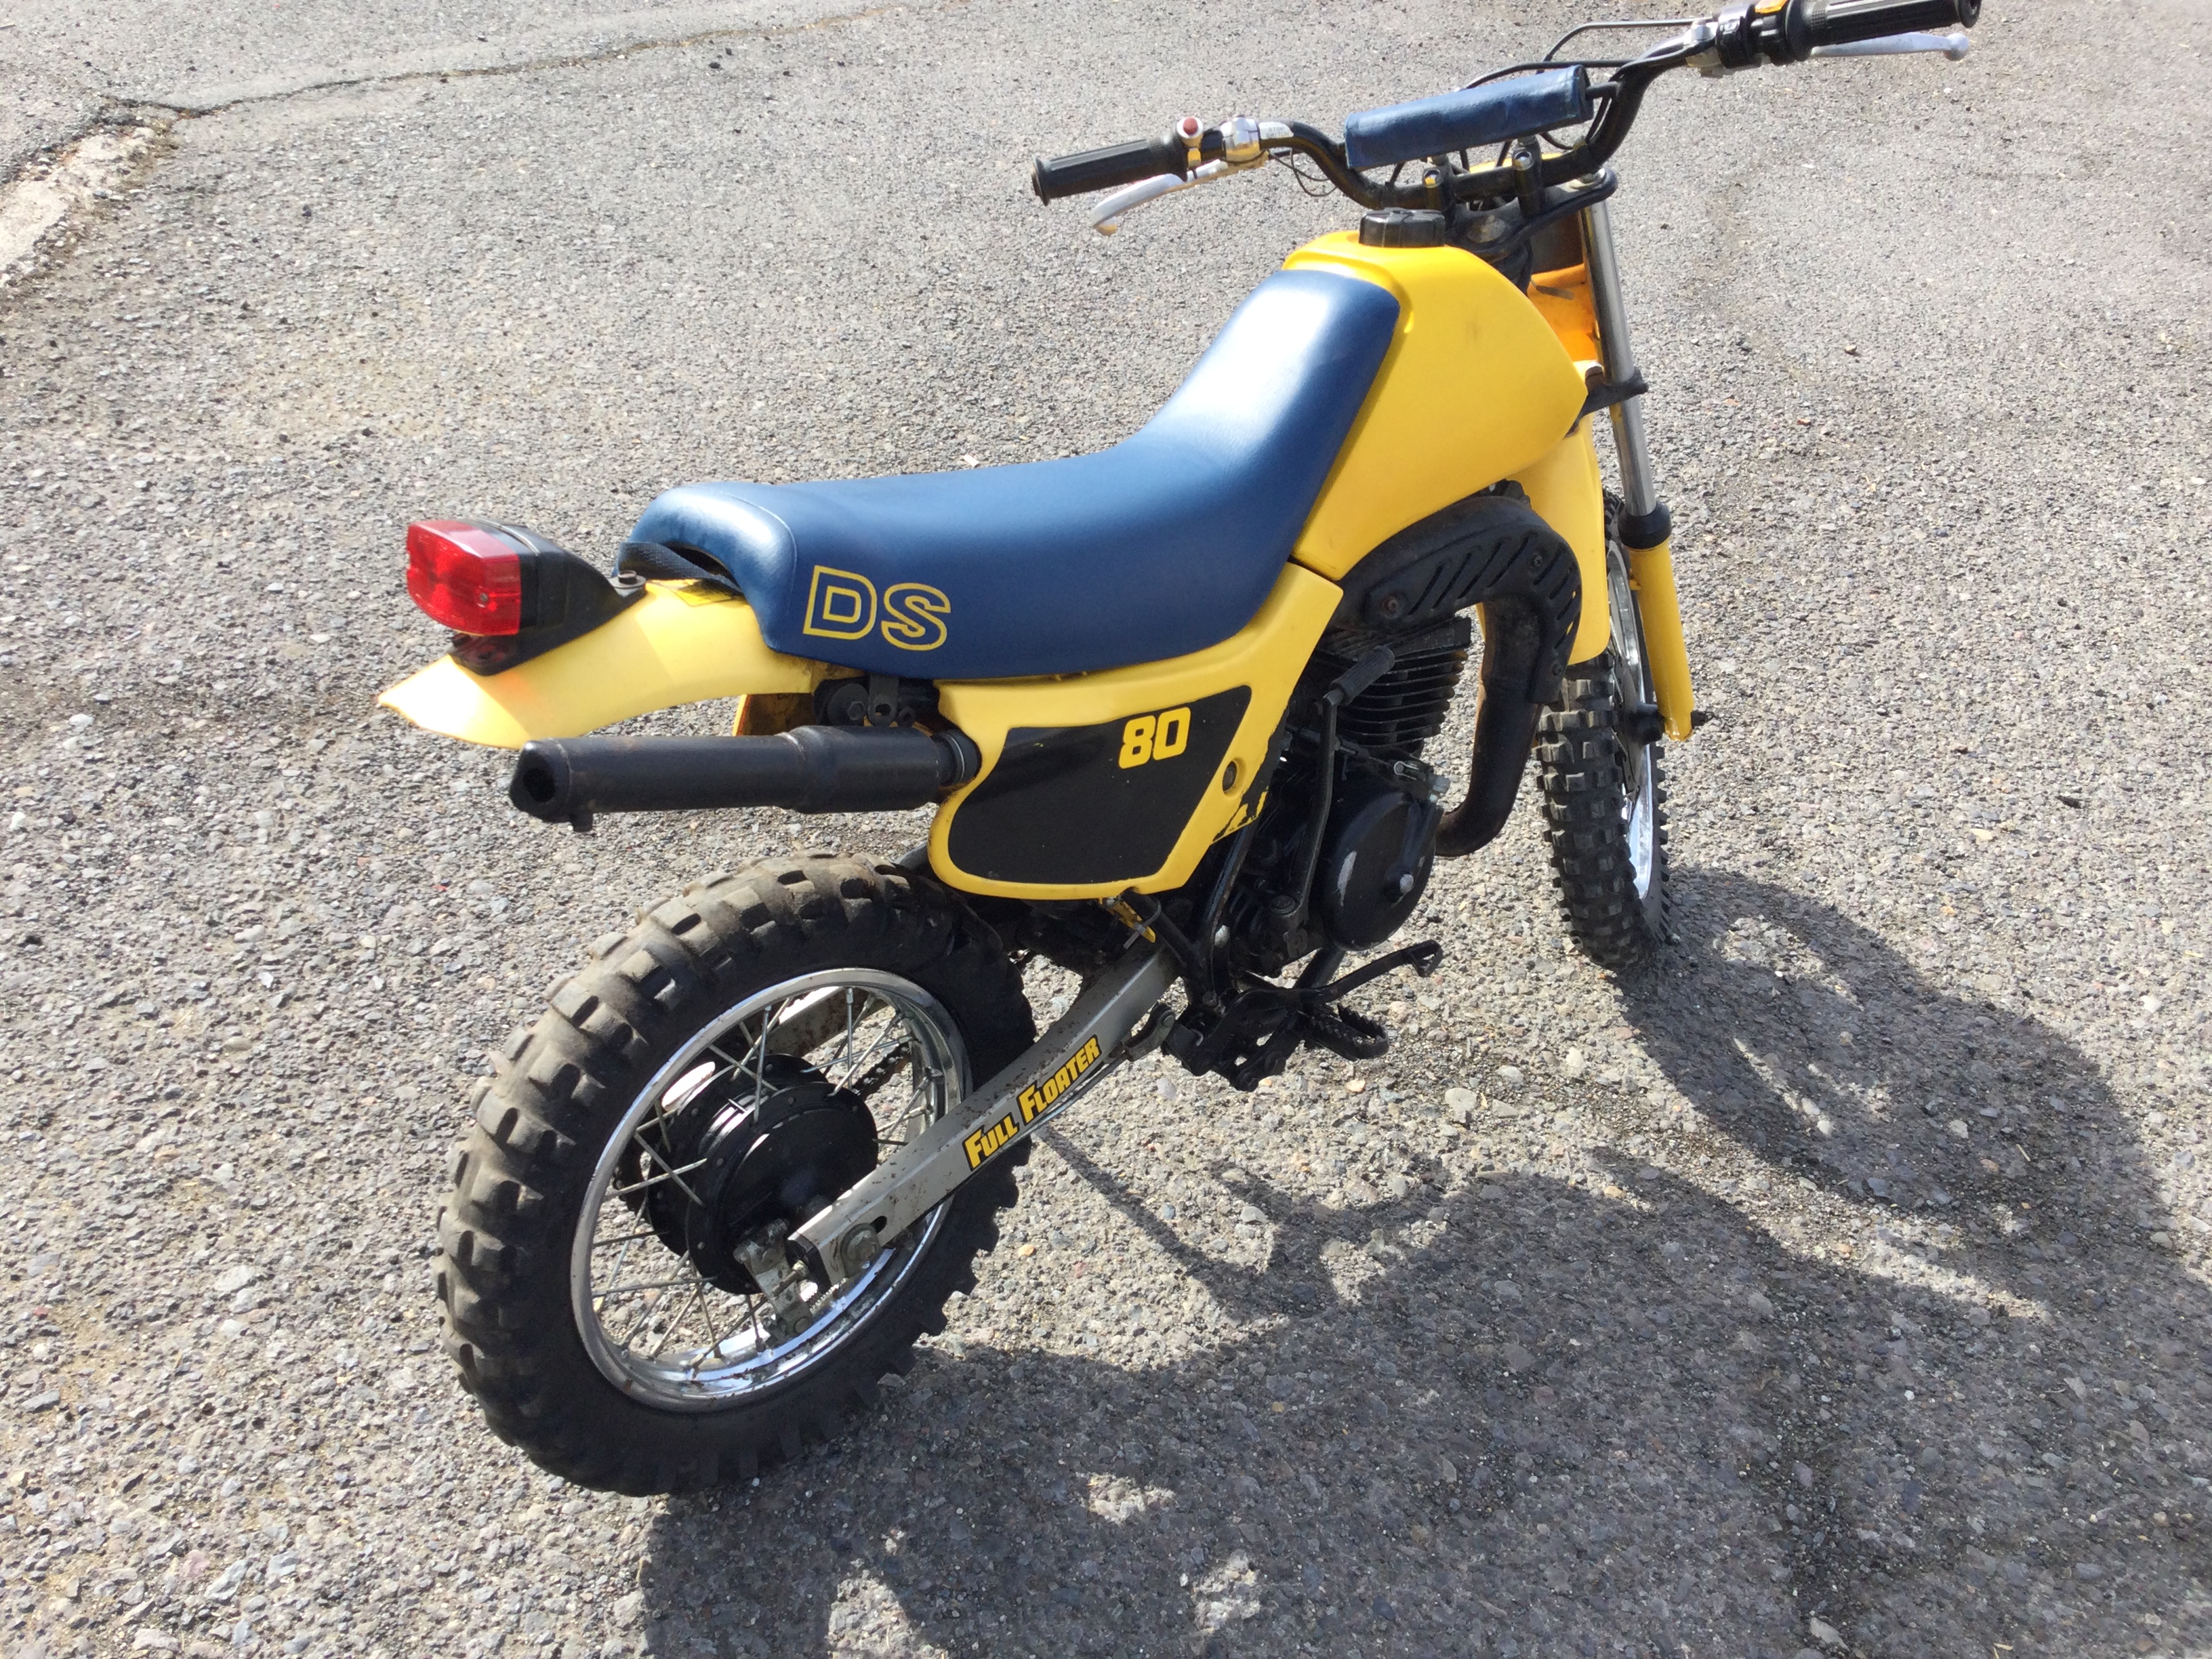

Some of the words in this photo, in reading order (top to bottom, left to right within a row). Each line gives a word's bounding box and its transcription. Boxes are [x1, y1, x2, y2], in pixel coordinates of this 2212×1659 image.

[803, 565, 951, 651] DS
[1118, 707, 1191, 769] 80
[964, 1115, 1019, 1169] FULL
[1018, 1036, 1101, 1124] FLOATER
